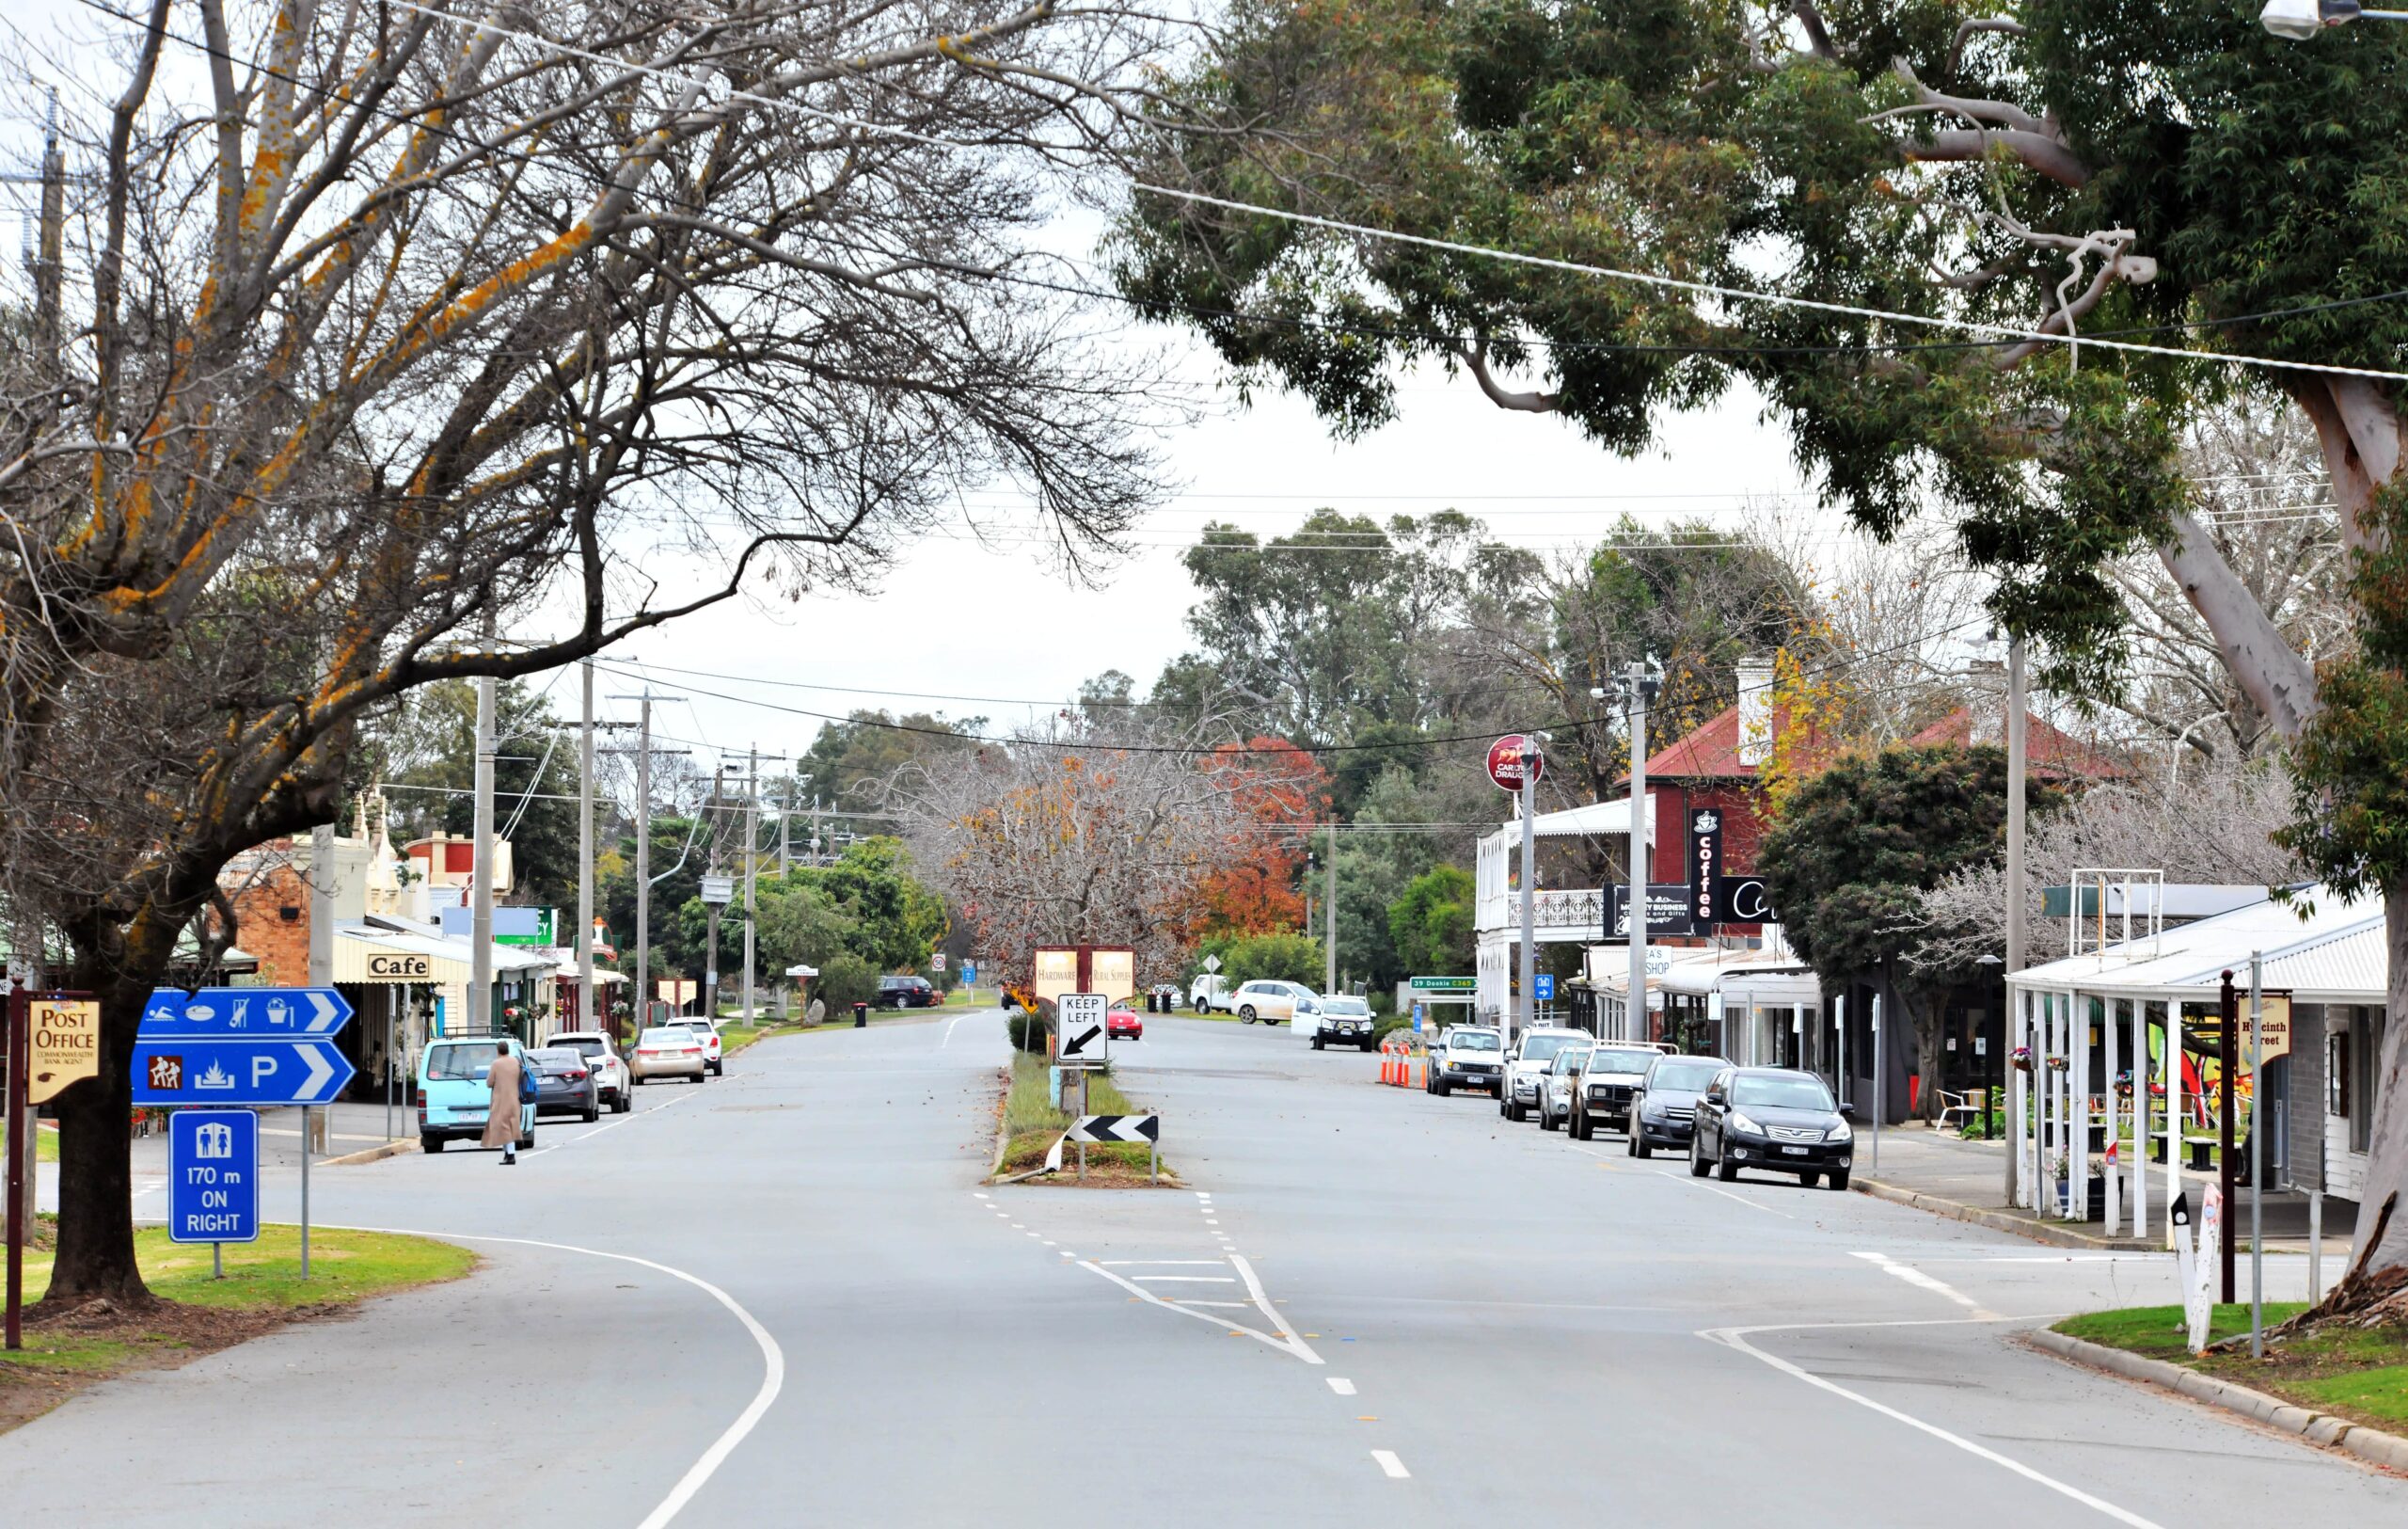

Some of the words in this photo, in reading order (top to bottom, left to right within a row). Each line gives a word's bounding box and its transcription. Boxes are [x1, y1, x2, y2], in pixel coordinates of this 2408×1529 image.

[1699, 836, 1712, 917] coffee
[371, 957, 427, 974] Cafe
[1038, 969, 1076, 980] HARDWARE
[1068, 999, 1099, 1009] KEEP
[1069, 1012, 1097, 1023] LEFT
[252, 1056, 277, 1088] P
[187, 1168, 216, 1185] 170
[224, 1171, 240, 1184] m
[202, 1190, 227, 1208] ON
[188, 1214, 240, 1232] RIGHT
